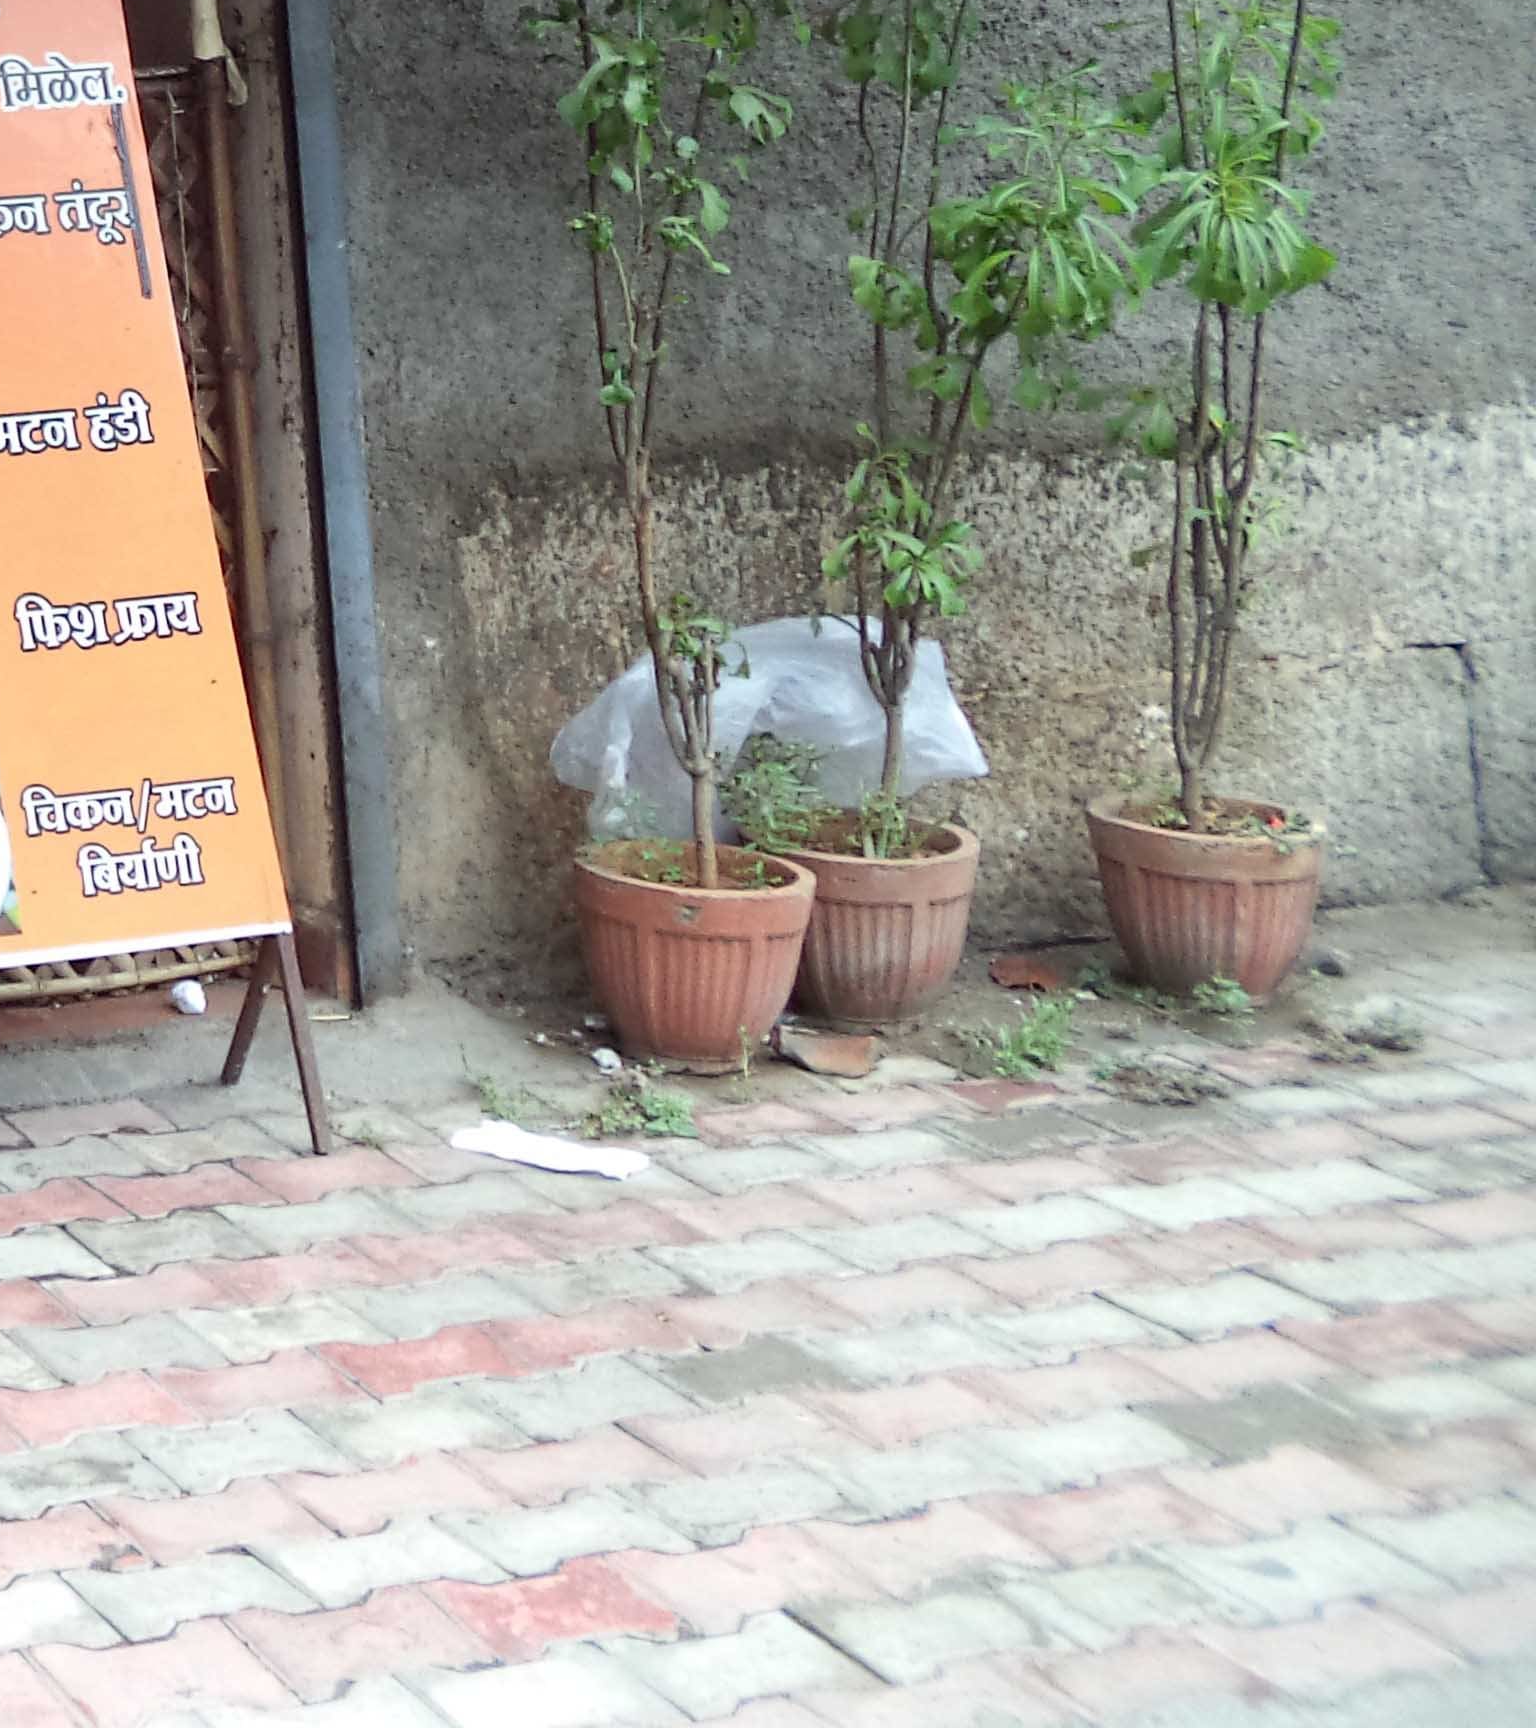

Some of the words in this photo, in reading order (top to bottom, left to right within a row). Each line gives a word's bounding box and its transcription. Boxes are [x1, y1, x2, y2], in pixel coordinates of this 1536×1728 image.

[83, 389, 155, 451] हंडी
[14, 593, 111, 653] फिश
[112, 591, 202, 646] फ्राय
